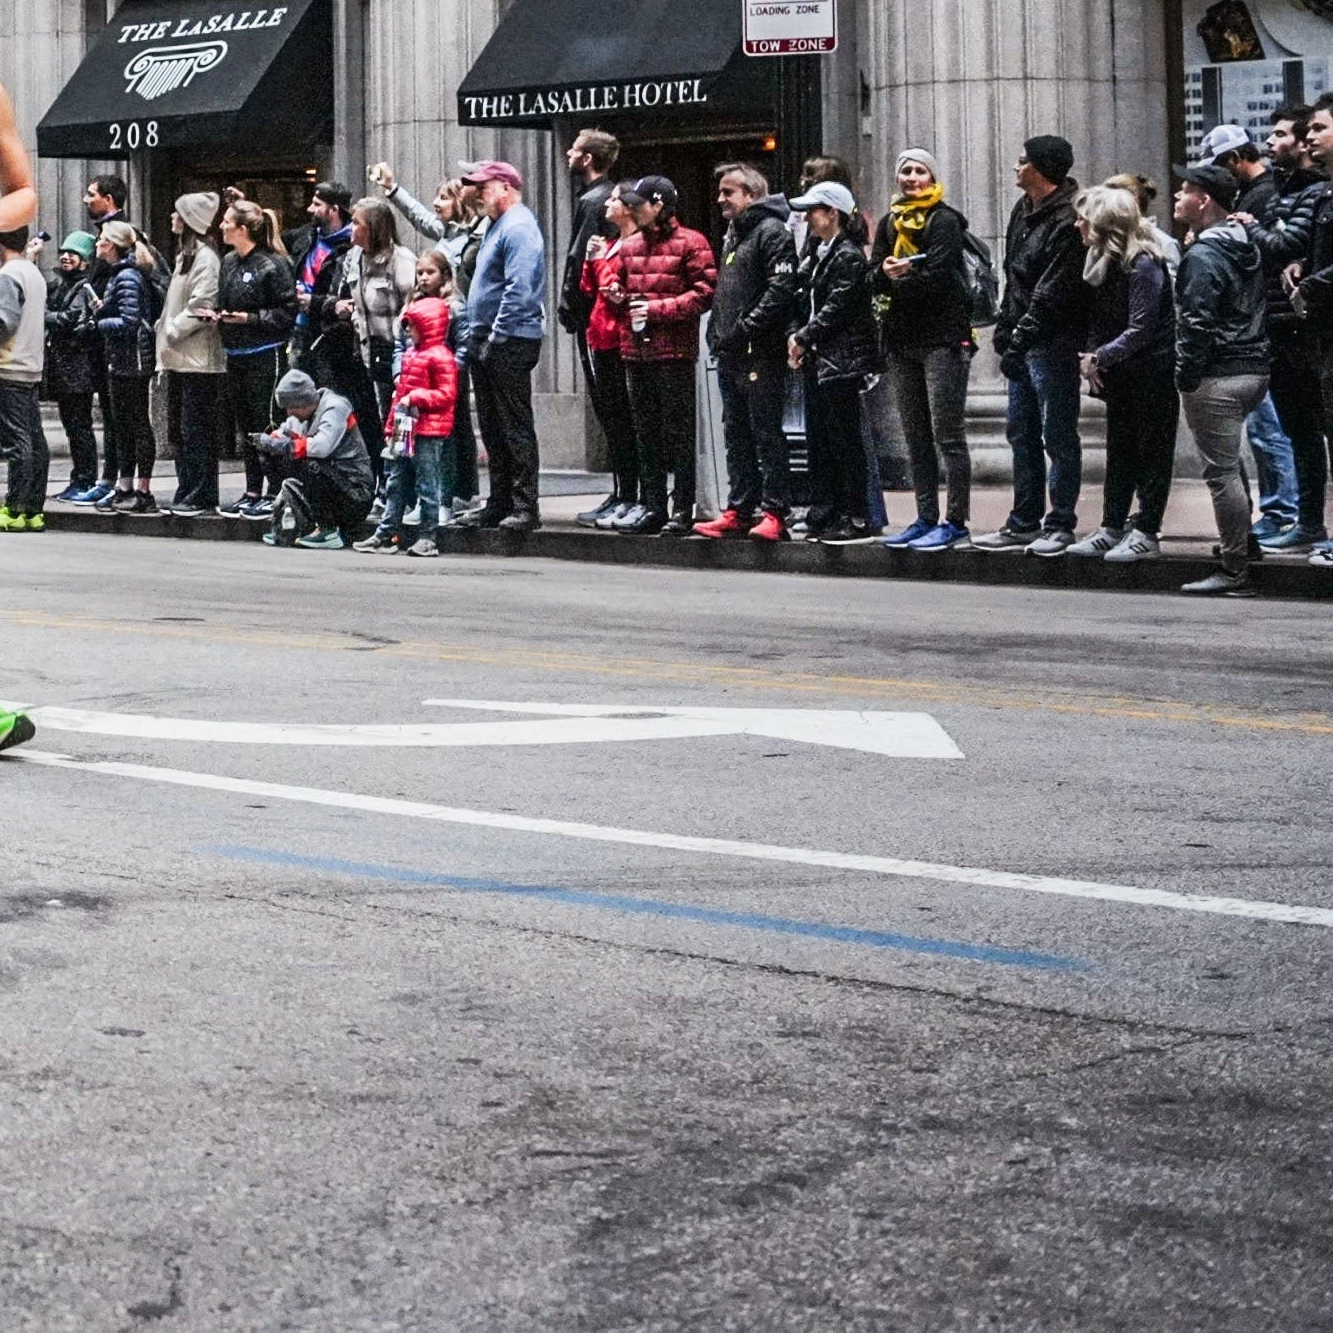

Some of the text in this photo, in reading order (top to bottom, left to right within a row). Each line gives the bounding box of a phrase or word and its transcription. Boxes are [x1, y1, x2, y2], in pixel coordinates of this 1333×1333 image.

[117, 7, 288, 43] THE LASALLE
[749, 5, 820, 17] LOADING ZONE
[751, 38, 827, 53] TOW ZONE
[464, 79, 707, 119] THE LASALLE HOTEL
[109, 120, 159, 149] 208
